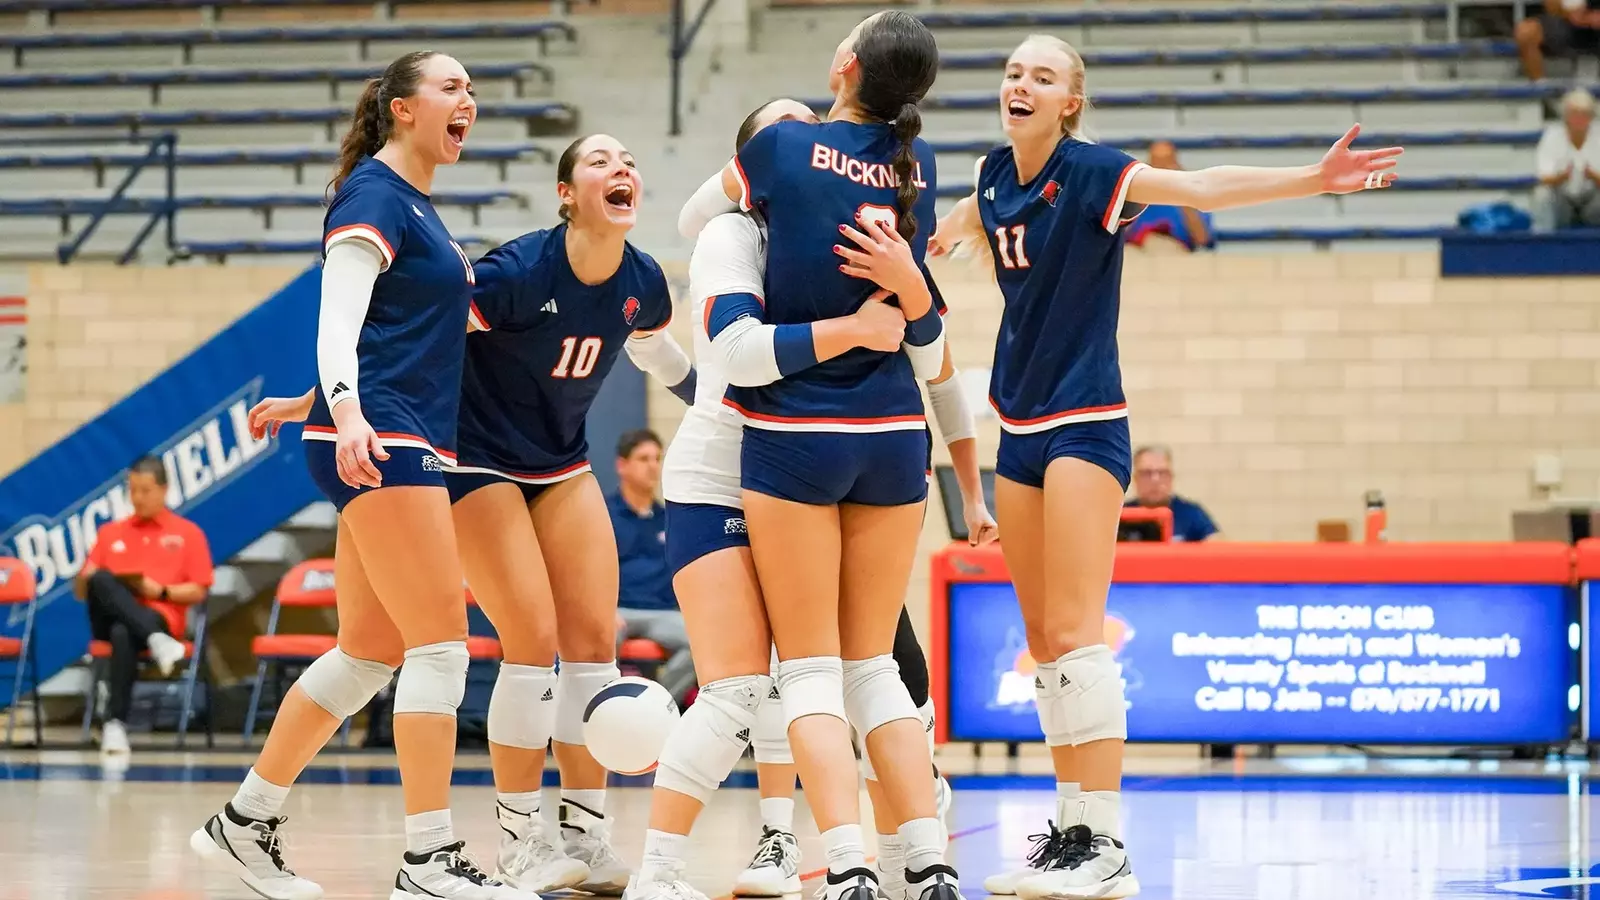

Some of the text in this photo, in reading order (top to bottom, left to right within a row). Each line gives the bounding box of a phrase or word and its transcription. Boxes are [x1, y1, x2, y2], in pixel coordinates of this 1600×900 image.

[811, 142, 927, 188] BUCKNL
[994, 223, 1032, 269] 11
[551, 336, 603, 379] 10
[1256, 605, 1298, 629] THE
[1374, 605, 1434, 630] CLUB
[1172, 632, 1521, 661] Enhancing Men's and Women's
[1287, 660, 1356, 687] Sports
[1387, 661, 1486, 685] Bucknell
[1195, 686, 1244, 711] Call
[1245, 687, 1271, 711] to
[1273, 687, 1322, 711] Join
